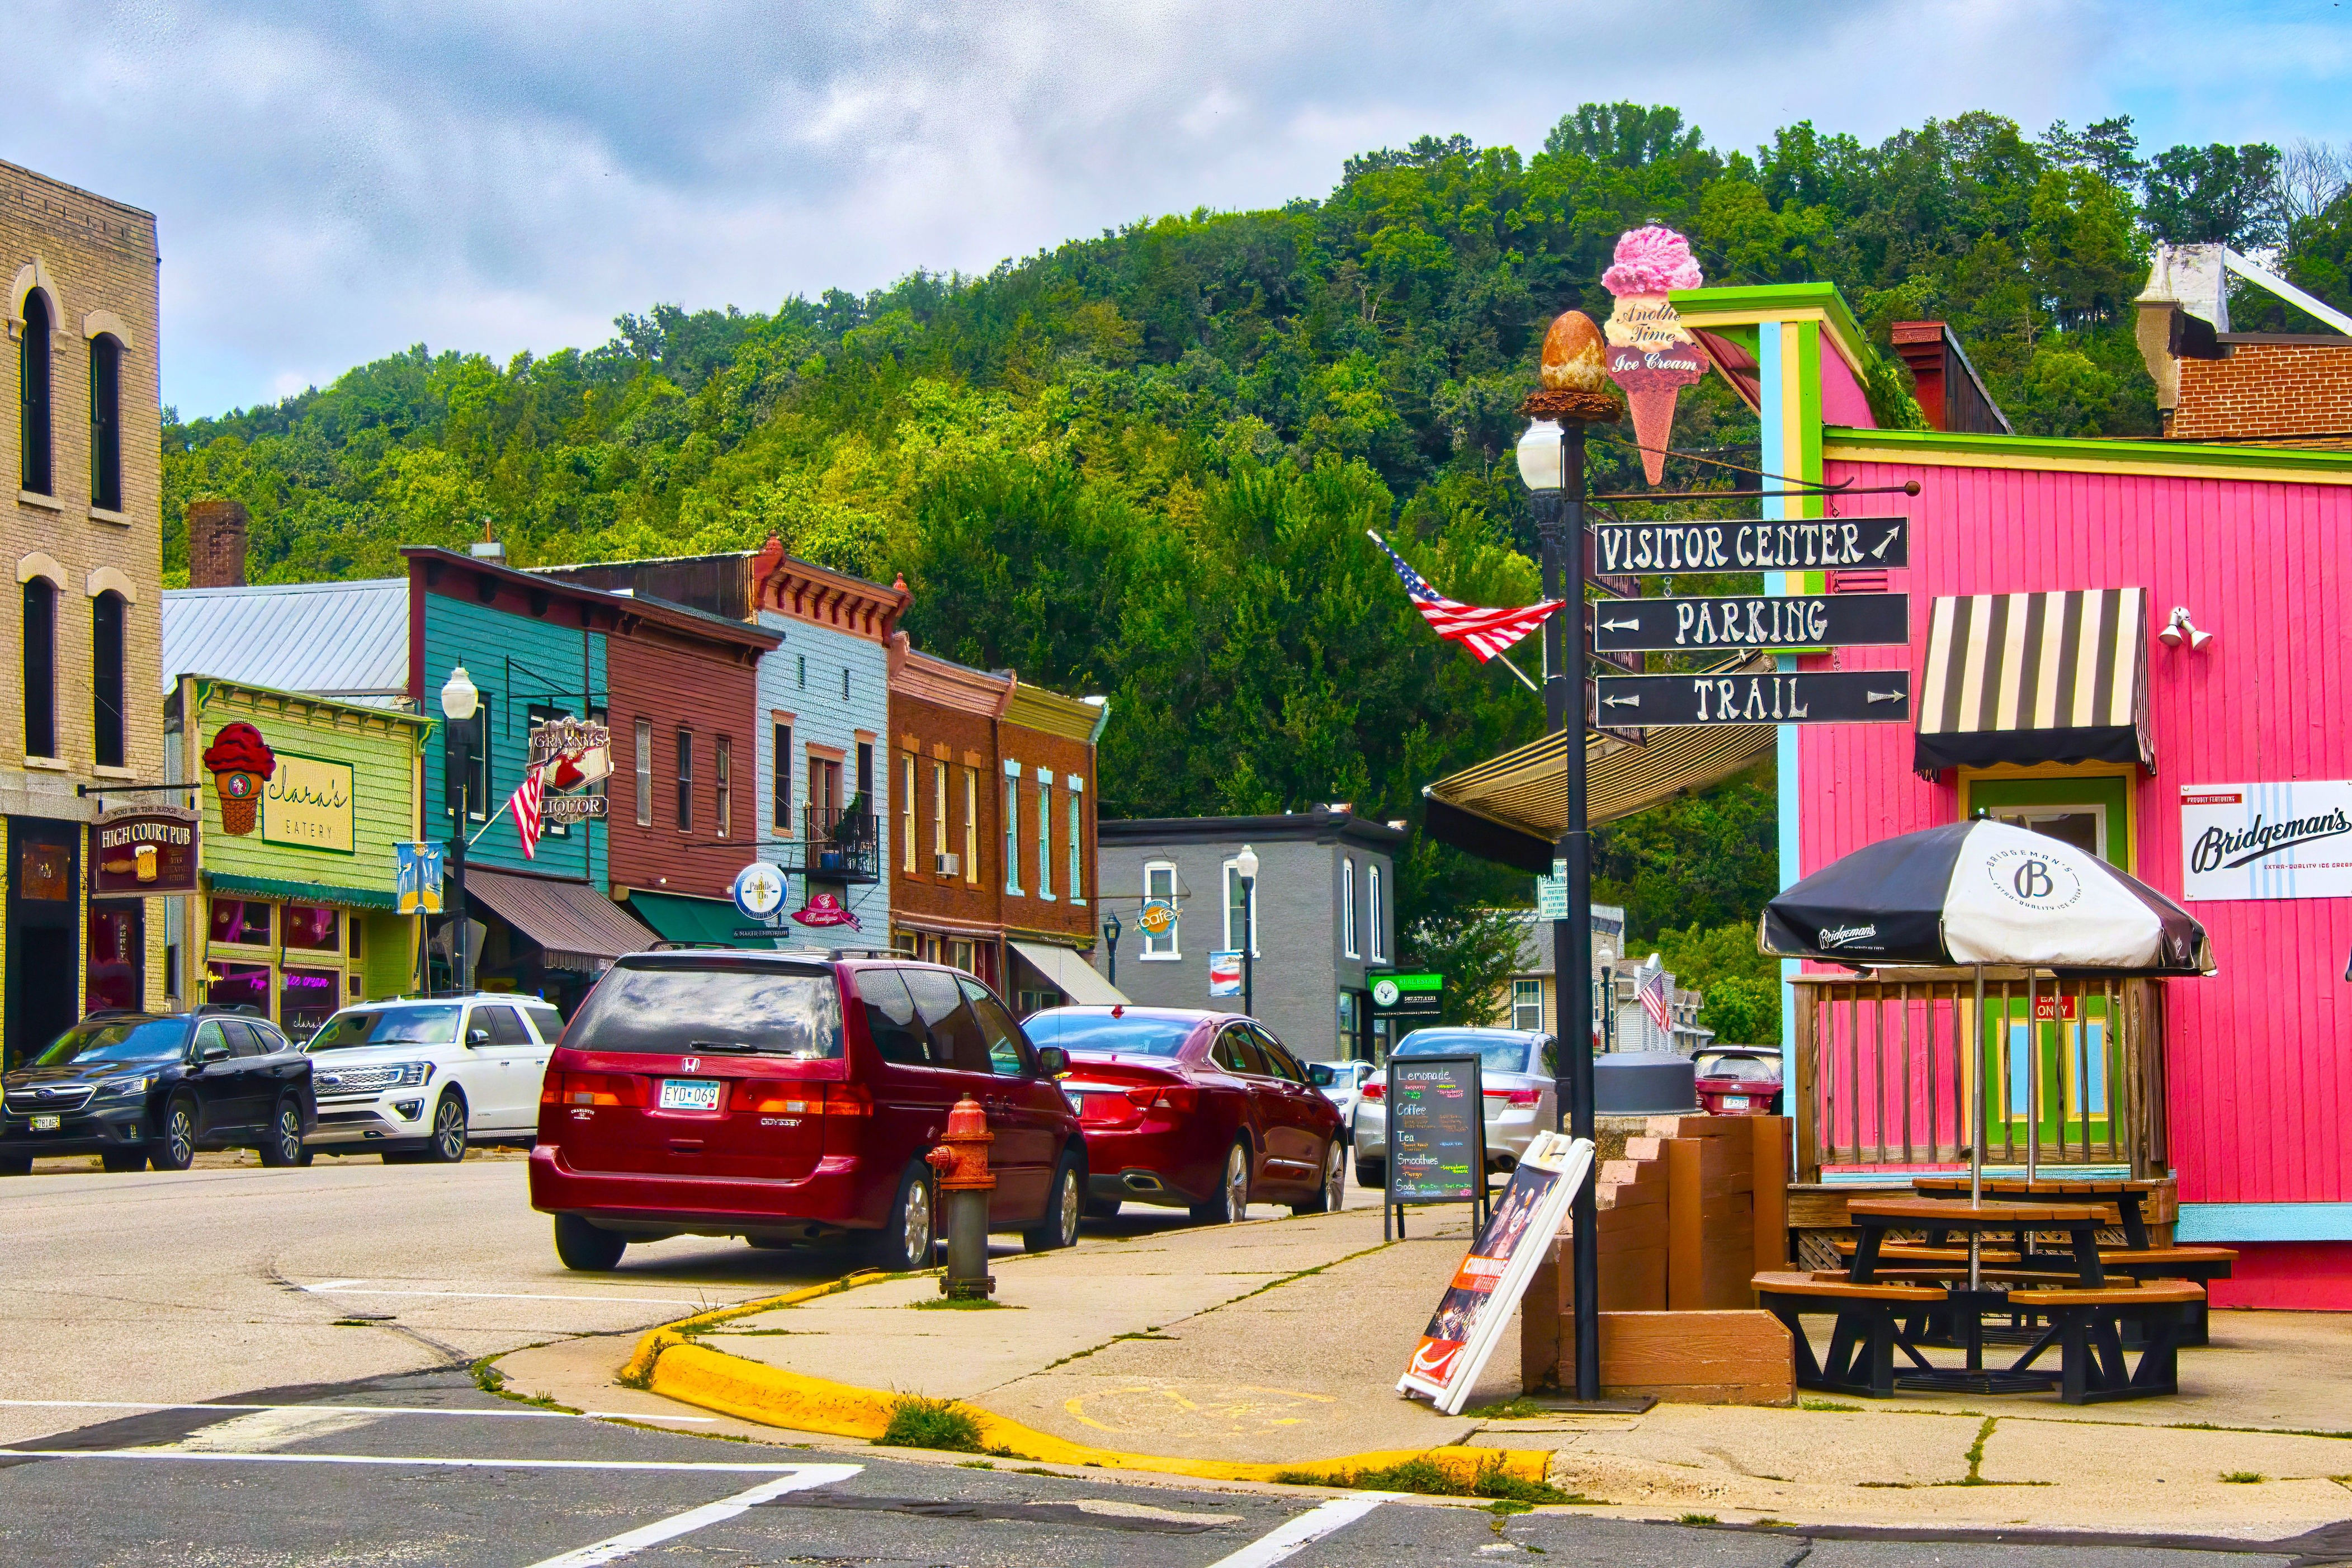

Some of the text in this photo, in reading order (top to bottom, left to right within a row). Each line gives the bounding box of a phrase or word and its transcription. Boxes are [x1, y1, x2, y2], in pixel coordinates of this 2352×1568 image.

[1630, 324, 1675, 343] Time
[1612, 352, 1698, 373] Ice Cream
[1601, 523, 1865, 571] VISITOR CENTER
[1675, 600, 1829, 645] PARKING
[1694, 677, 1808, 721] TRAIL
[270, 764, 348, 808] clara's
[540, 800, 600, 816] LIQUOR
[102, 823, 191, 848] HIGH COURT PUB
[286, 820, 332, 839] EATERY
[2192, 807, 2352, 874] Bridgeman's
[1986, 850, 2073, 872] BRIDGEMAN'S
[1819, 923, 1876, 950] Bridgeman's
[2038, 1005, 2067, 1017] ONY
[1398, 1066, 1451, 1080] Lemonade
[665, 1087, 715, 1102] EYD 069
[1397, 1103, 1427, 1116] Coffee
[1397, 1131, 1415, 1142] Tea
[1398, 1153, 1438, 1165] Smoothies
[1396, 1178, 1416, 1192] Soda
